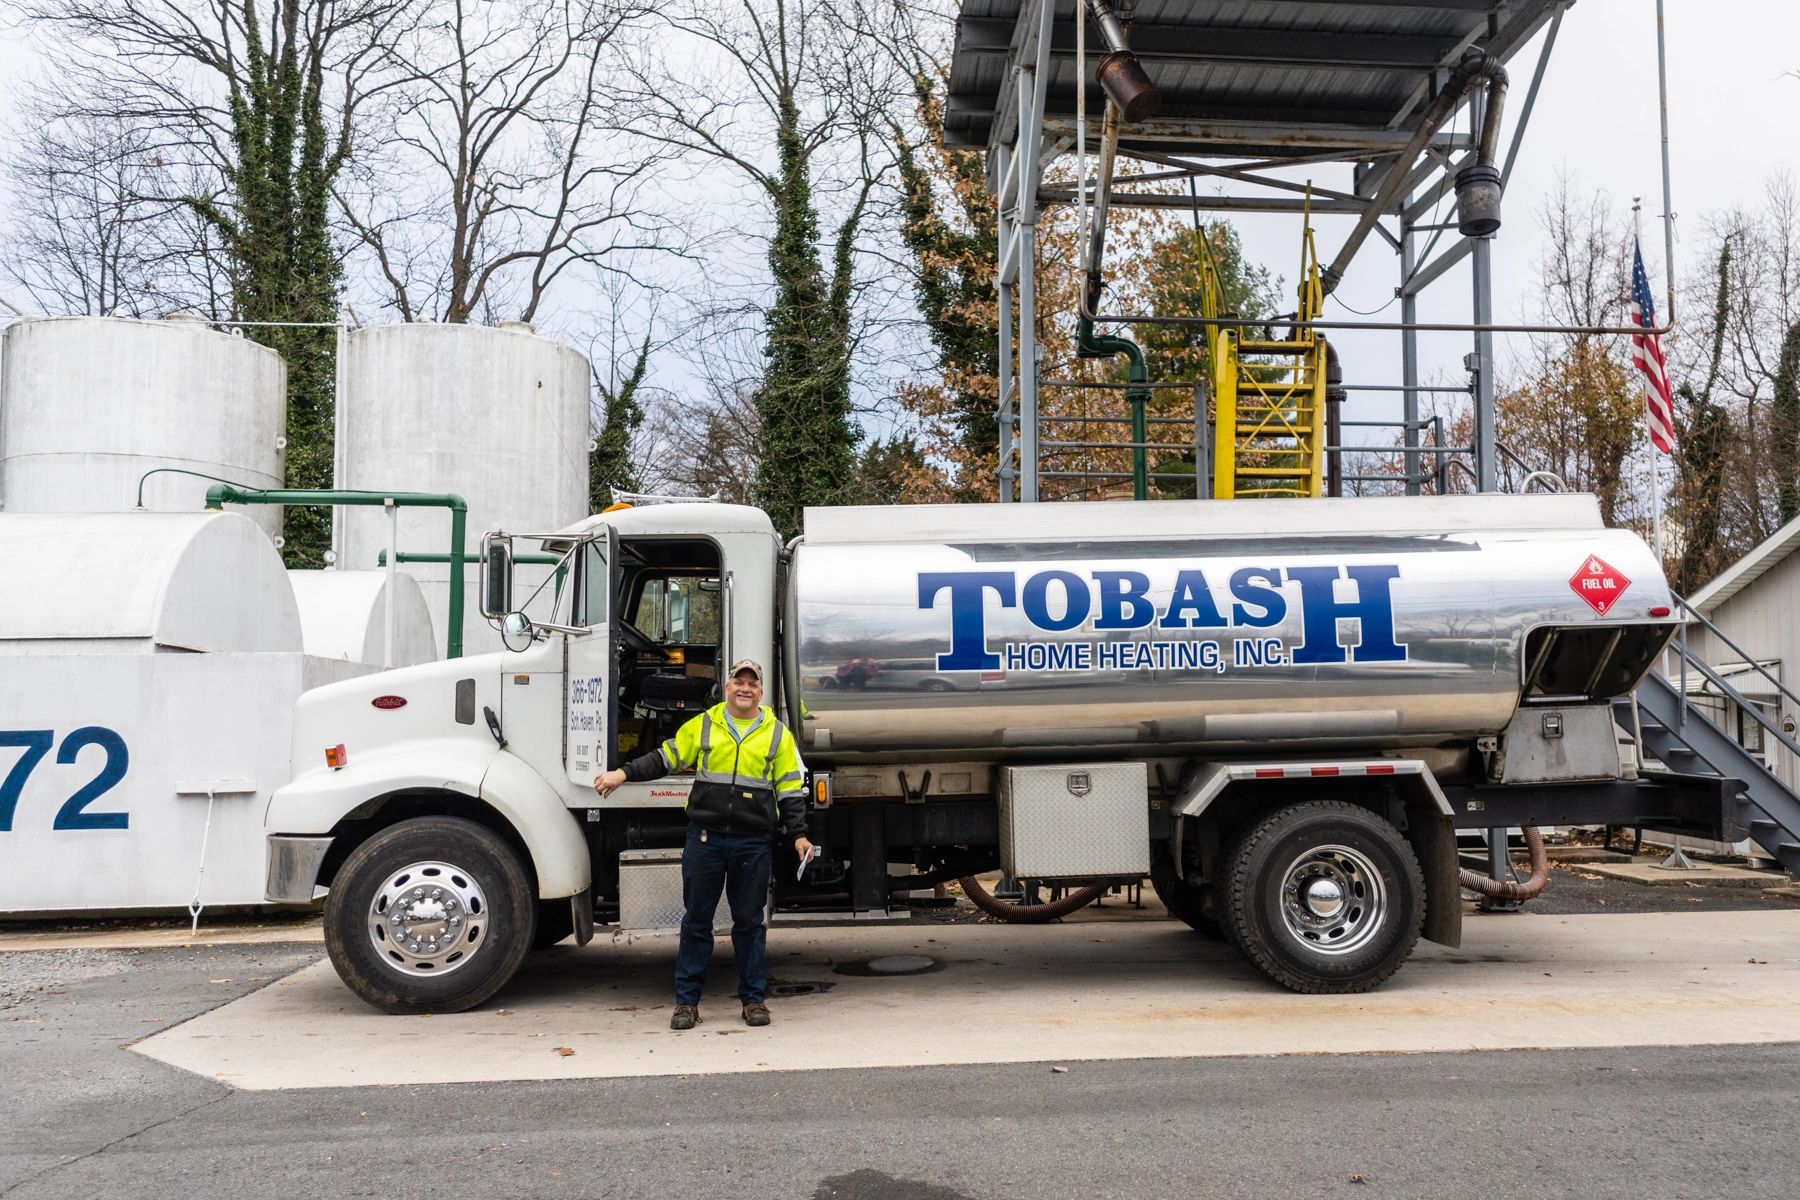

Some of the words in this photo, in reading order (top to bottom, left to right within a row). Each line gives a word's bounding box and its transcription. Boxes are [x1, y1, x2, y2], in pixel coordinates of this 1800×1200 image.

[1582, 578, 1602, 590] FUEL
[1602, 577, 1617, 589] OIL
[917, 564, 1407, 673] TOBASH
[1598, 601, 1605, 610] 3
[1007, 643, 1091, 670] HOME
[1098, 640, 1226, 673] HEATING,
[1235, 639, 1288, 667] INC.
[572, 677, 603, 704] 366-1972
[0, 725, 130, 832] 72
